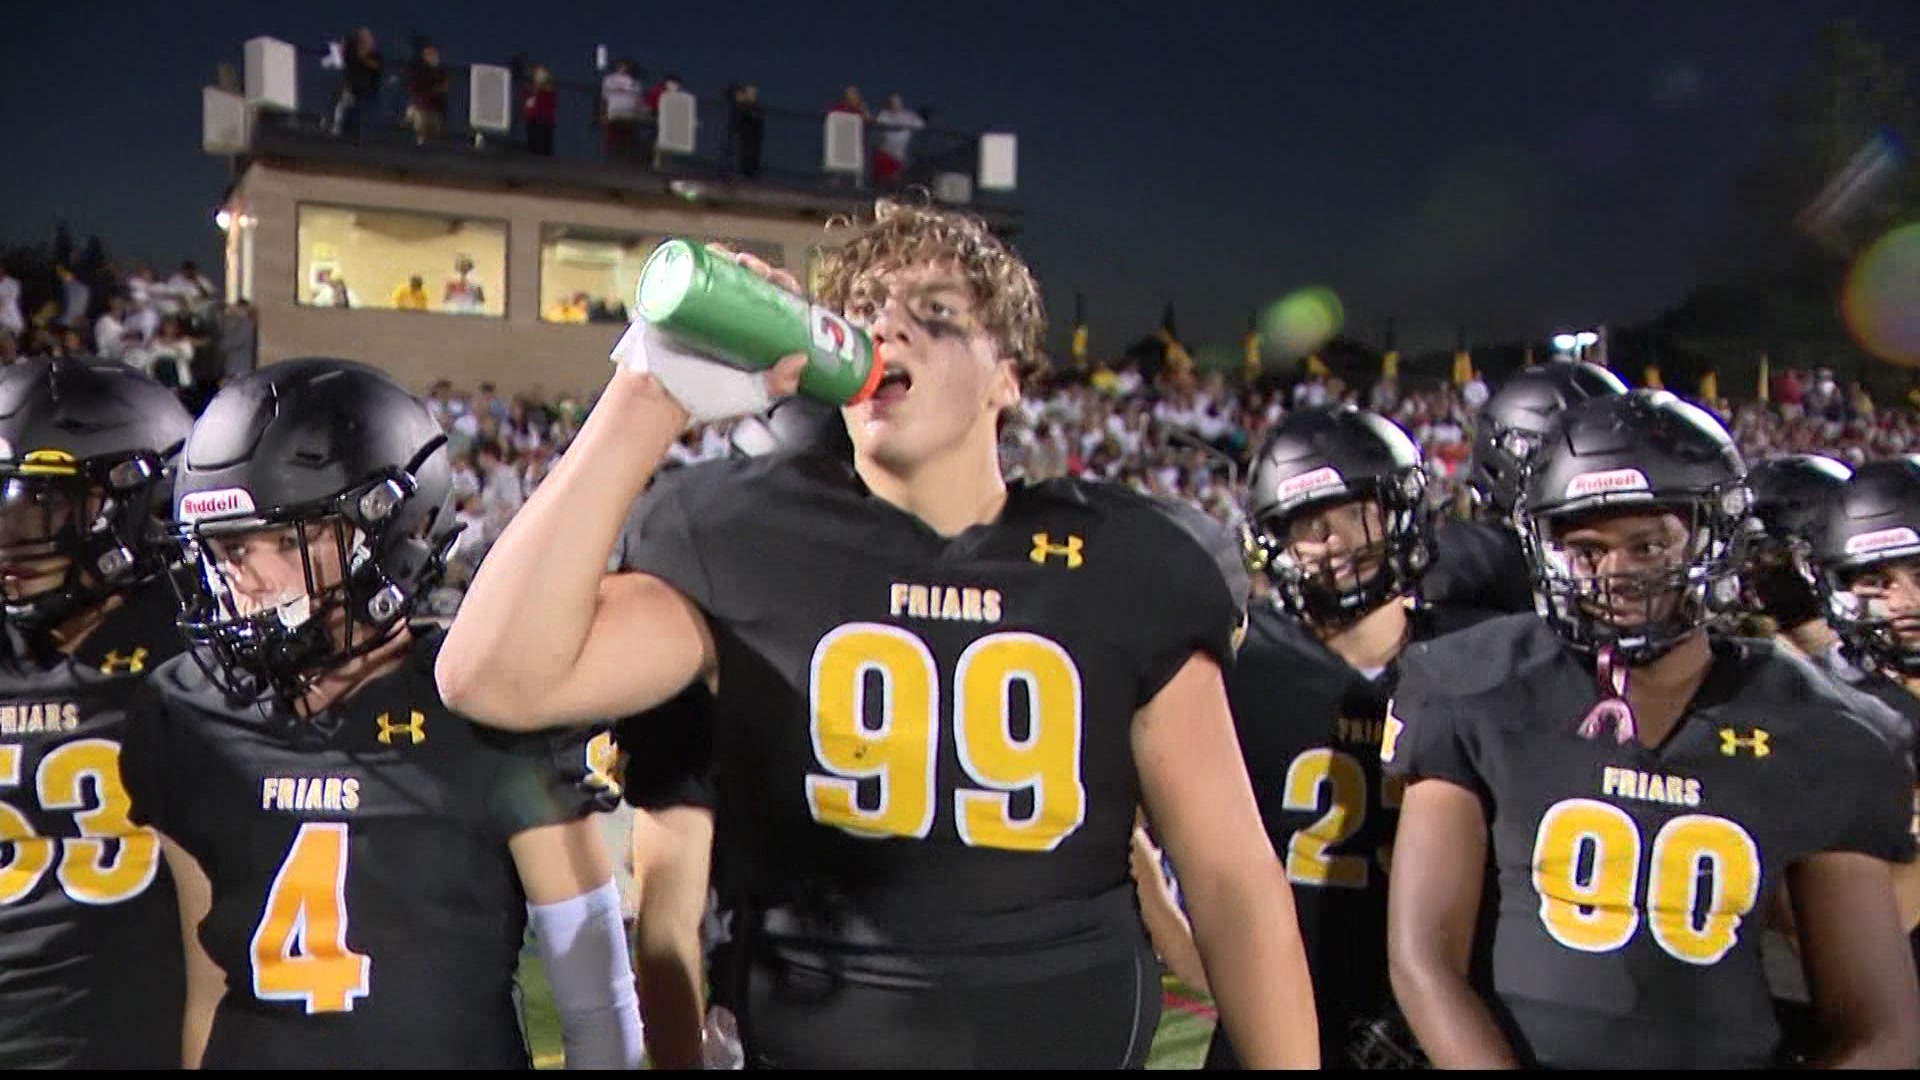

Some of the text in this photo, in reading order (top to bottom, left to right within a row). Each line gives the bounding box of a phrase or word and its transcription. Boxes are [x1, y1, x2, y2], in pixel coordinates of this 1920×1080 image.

[184, 494, 239, 513] Riddell
[890, 583, 1002, 622] FRIARS
[0, 703, 80, 733] RIARS
[805, 621, 1086, 851] 99
[262, 777, 361, 811] FRIARS
[1603, 765, 1701, 806] FRIARS
[1532, 798, 1761, 965] 90
[250, 822, 371, 1015] 4
